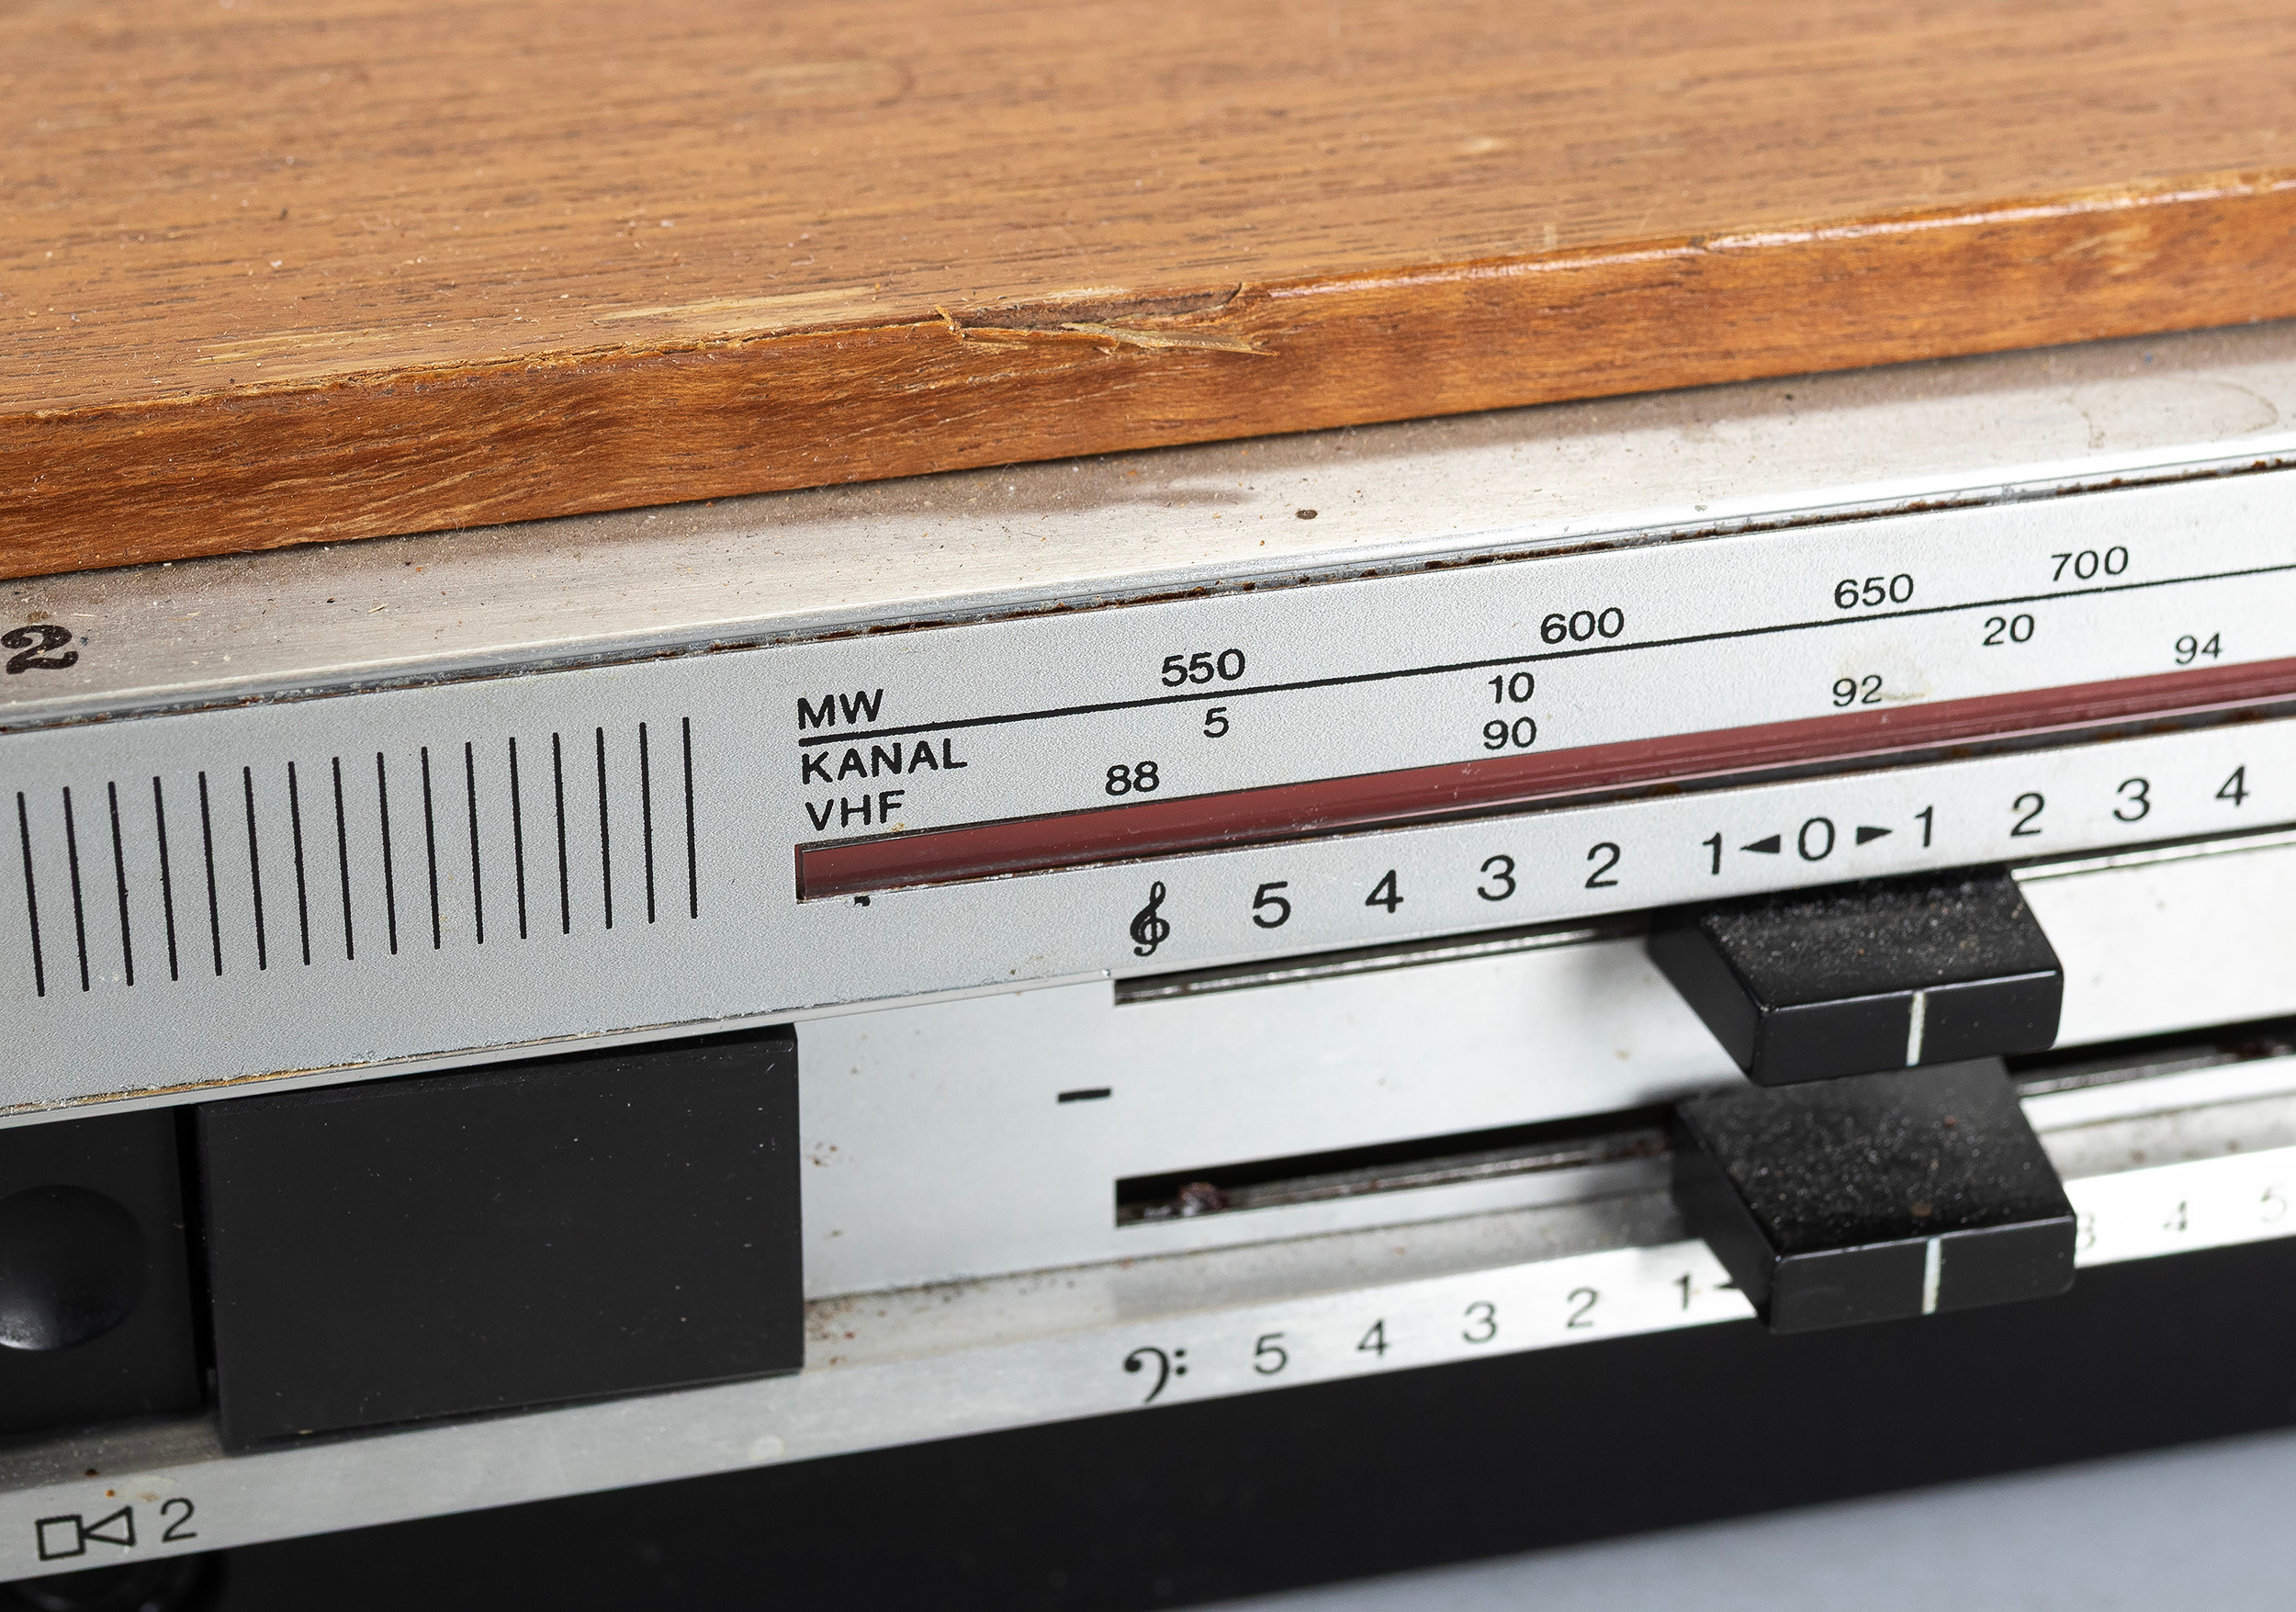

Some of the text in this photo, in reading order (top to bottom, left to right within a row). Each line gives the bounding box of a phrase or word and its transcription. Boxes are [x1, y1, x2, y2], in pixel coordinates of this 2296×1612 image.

[0, 625, 79, 675] 2
[796, 547, 2128, 730] MW 550 600 650 700
[801, 614, 2034, 785] KANAL 5 10 20
[805, 632, 2223, 831] VHF 88 90 92 94
[1253, 766, 2247, 929] 5 4 3 2 1 0 1 2 3 4
[1254, 1333, 1289, 1376] 5
[1357, 1319, 1390, 1357] 4
[1462, 1302, 1498, 1345] 3
[1567, 1288, 1598, 1328] 2
[1672, 1272, 1692, 1311] 1
[2163, 1199, 2189, 1233] 4
[2259, 1183, 2288, 1223] 5
[161, 1498, 197, 1542] 2
